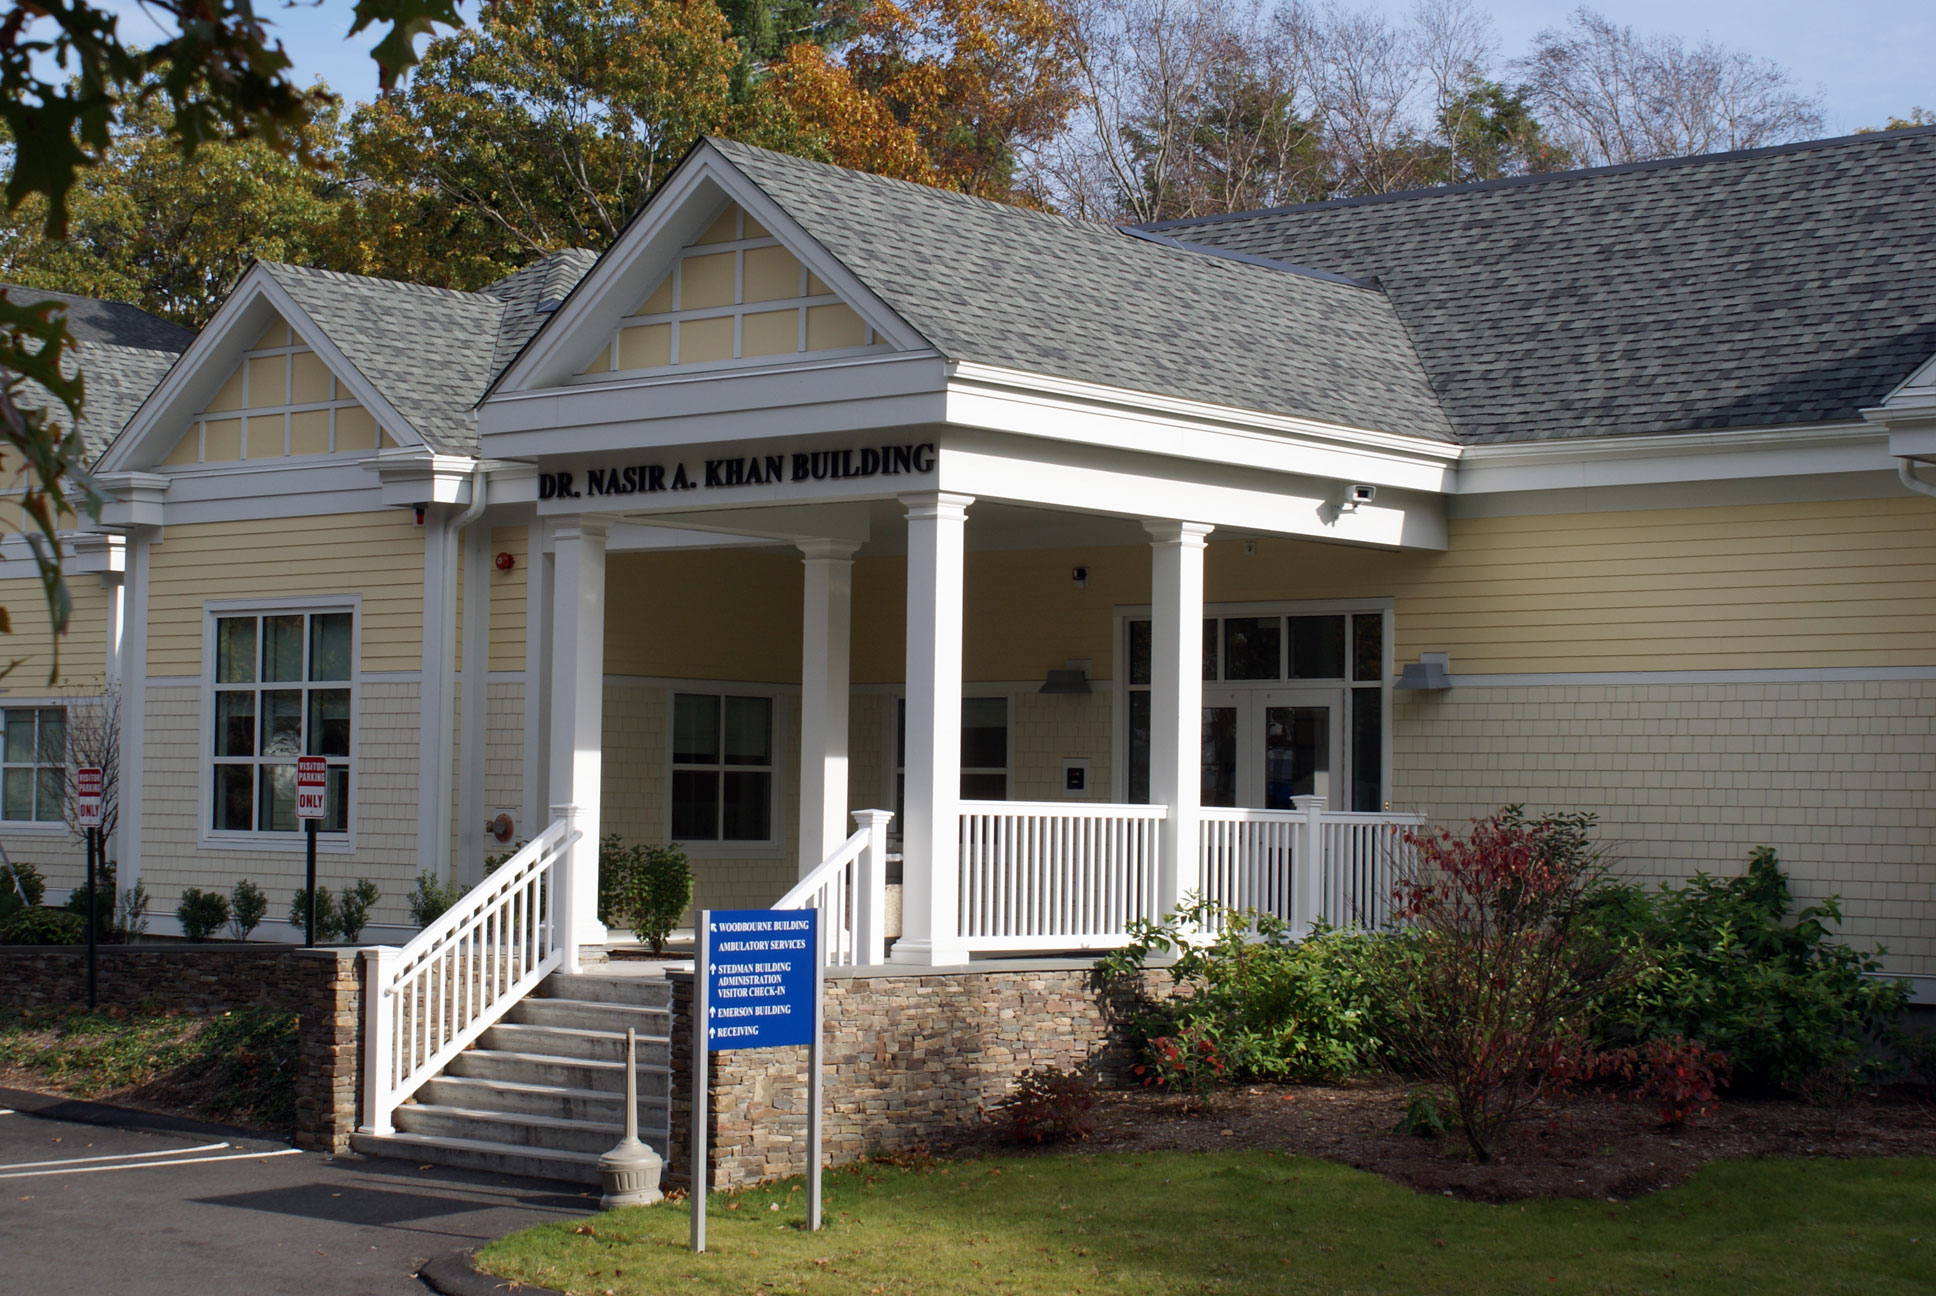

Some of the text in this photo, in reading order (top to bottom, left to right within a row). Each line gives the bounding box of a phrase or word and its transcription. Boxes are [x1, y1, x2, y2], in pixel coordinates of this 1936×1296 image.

[538, 443, 935, 499] DR. NASIR A. KHAN BUILDING
[299, 761, 325, 771] VISITOR
[299, 772, 325, 782] PARKING
[300, 794, 324, 808] ONLY
[80, 803, 100, 817] ONLY
[719, 920, 809, 932] WOODBOURNE BUILDING
[718, 939, 806, 952] AMBULATORY SERVICES
[718, 962, 791, 974] STEDMAN BUILDING
[718, 974, 782, 986] ADMINISTRATION
[718, 986, 785, 998] VISITOR CHECK-IN
[718, 1004, 791, 1018] EMERSON BUILDING
[717, 1025, 759, 1037] RECEIVING
